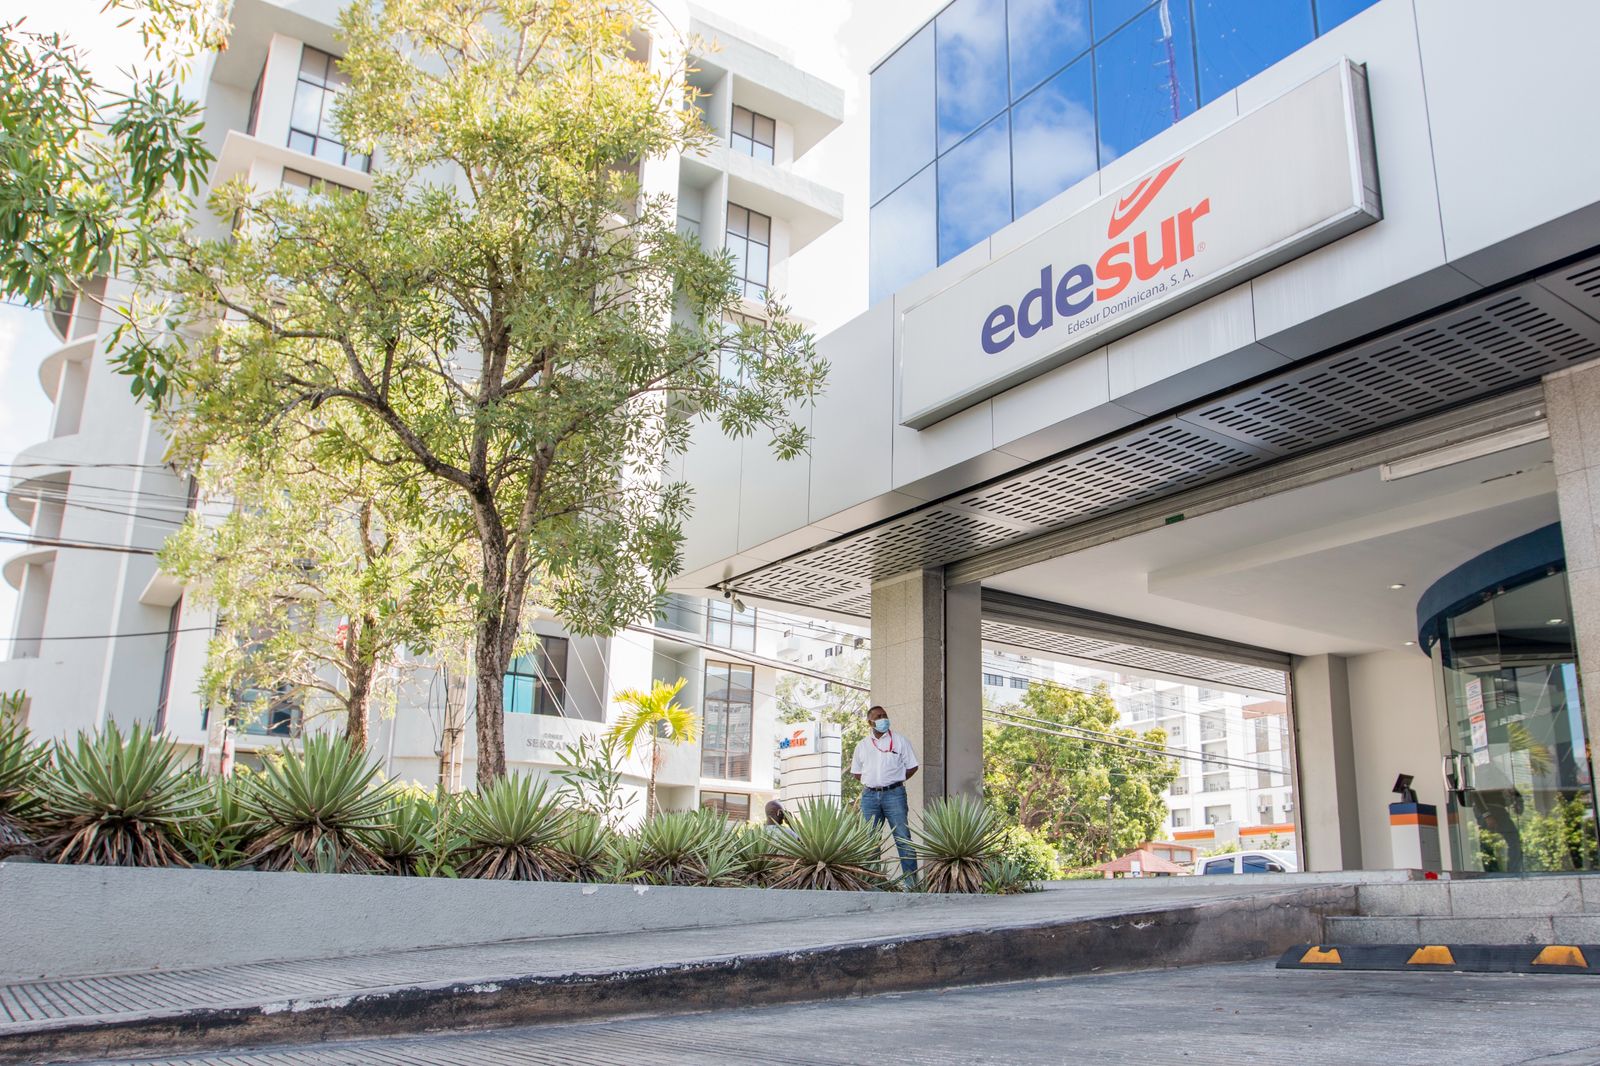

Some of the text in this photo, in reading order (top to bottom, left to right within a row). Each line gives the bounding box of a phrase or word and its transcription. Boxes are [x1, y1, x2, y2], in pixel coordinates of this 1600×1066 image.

[981, 198, 1210, 354] edesur
[1067, 313, 1100, 335] Edesur
[1102, 283, 1168, 319] Dominicana,
